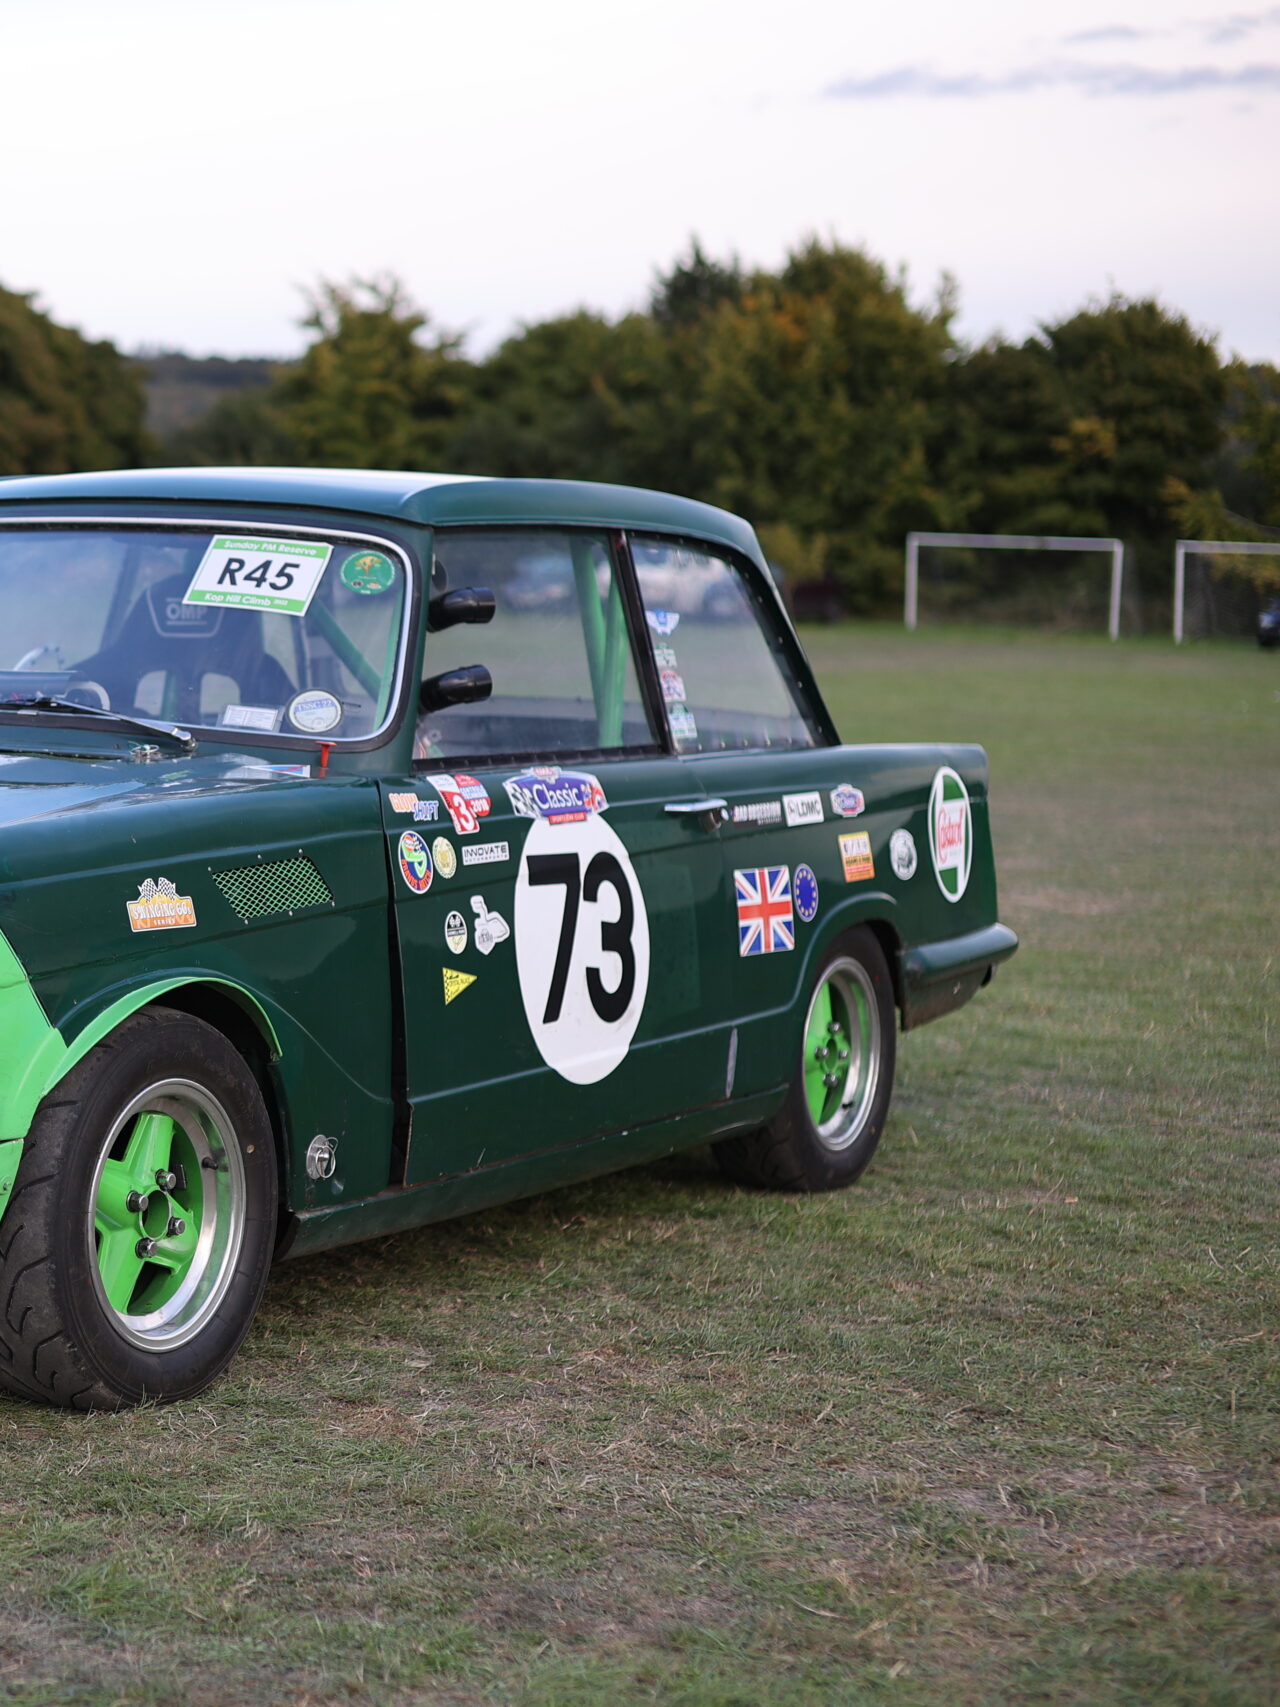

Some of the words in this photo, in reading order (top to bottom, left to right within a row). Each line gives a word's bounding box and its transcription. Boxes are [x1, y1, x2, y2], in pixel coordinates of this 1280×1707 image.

[224, 540, 260, 551] Sunday
[261, 543, 277, 551] PM
[278, 544, 318, 556] Reserve
[217, 557, 301, 591] R45
[204, 593, 224, 604] Kop
[225, 593, 241, 604] Hill
[241, 595, 271, 607] Climb
[166, 603, 208, 620] OMP
[533, 783, 582, 810] Classic
[798, 799, 820, 817] LDMC
[938, 804, 964, 864] Castrol
[464, 844, 507, 857] INNOVATE
[133, 903, 175, 919] SWINGING
[526, 852, 636, 1024] 73
